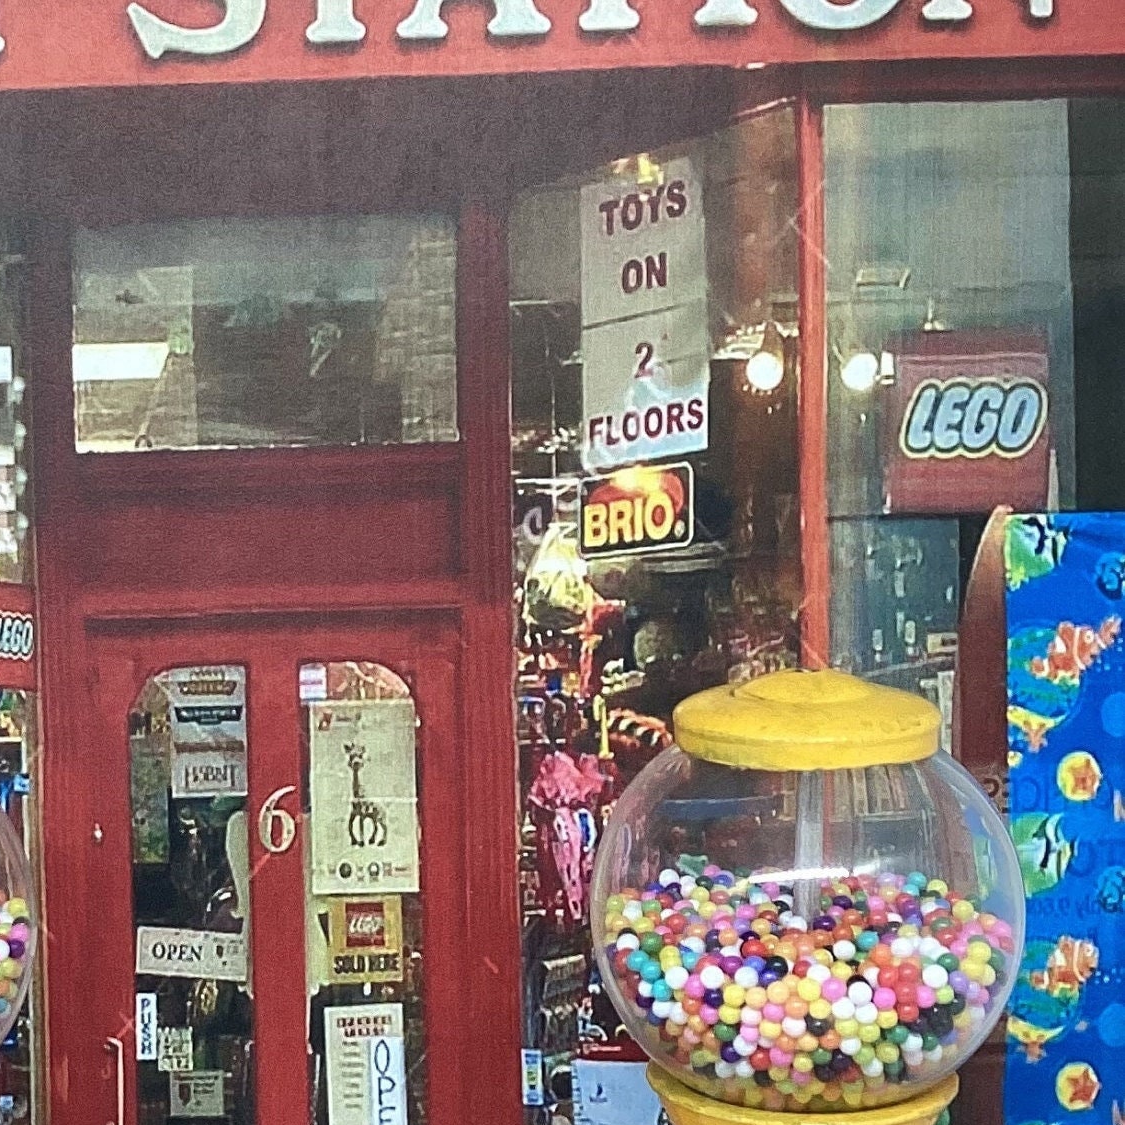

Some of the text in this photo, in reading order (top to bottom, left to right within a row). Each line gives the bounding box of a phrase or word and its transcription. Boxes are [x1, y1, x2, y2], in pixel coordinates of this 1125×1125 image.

[598, 180, 688, 237] TOYS
[621, 252, 668, 295] ON
[634, 342, 655, 380] 2
[588, 400, 706, 450] FLOORS
[904, 378, 1048, 457] LEGO
[259, 785, 297, 853] 6
[151, 941, 203, 961] OPEN
[139, 998, 153, 1056] PUSH
